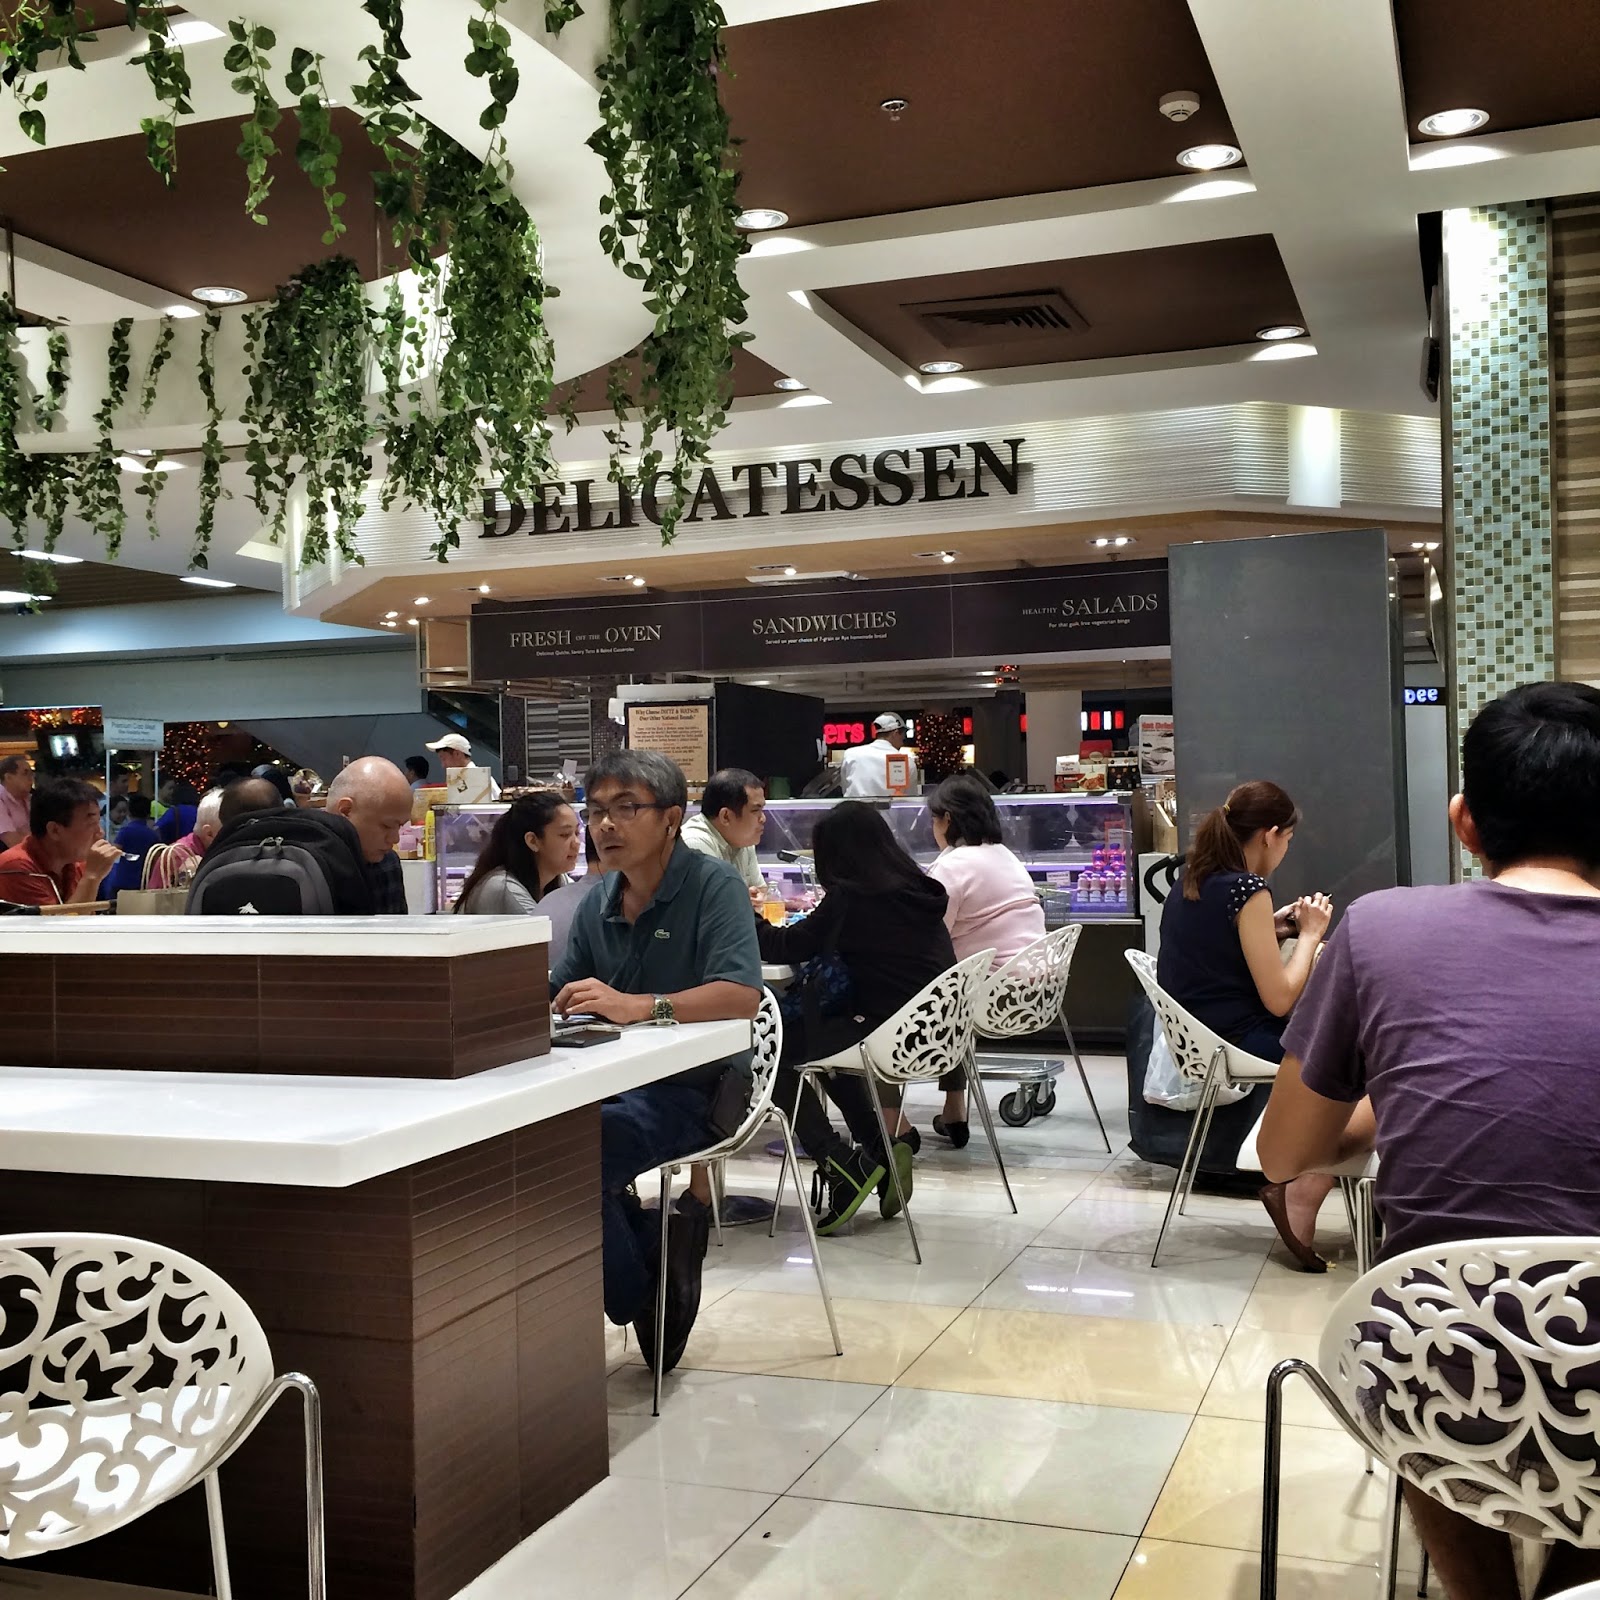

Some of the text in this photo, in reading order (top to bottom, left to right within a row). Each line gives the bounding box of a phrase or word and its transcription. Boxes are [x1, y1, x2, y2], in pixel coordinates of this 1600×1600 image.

[478, 438, 1026, 538] DELICATESSEN
[1022, 593, 1158, 616] HEALTHY SALADS
[752, 610, 897, 635] SANDWICHES
[510, 630, 571, 647] FRESH
[605, 625, 662, 642] OVEN
[1404, 688, 1438, 704] bee
